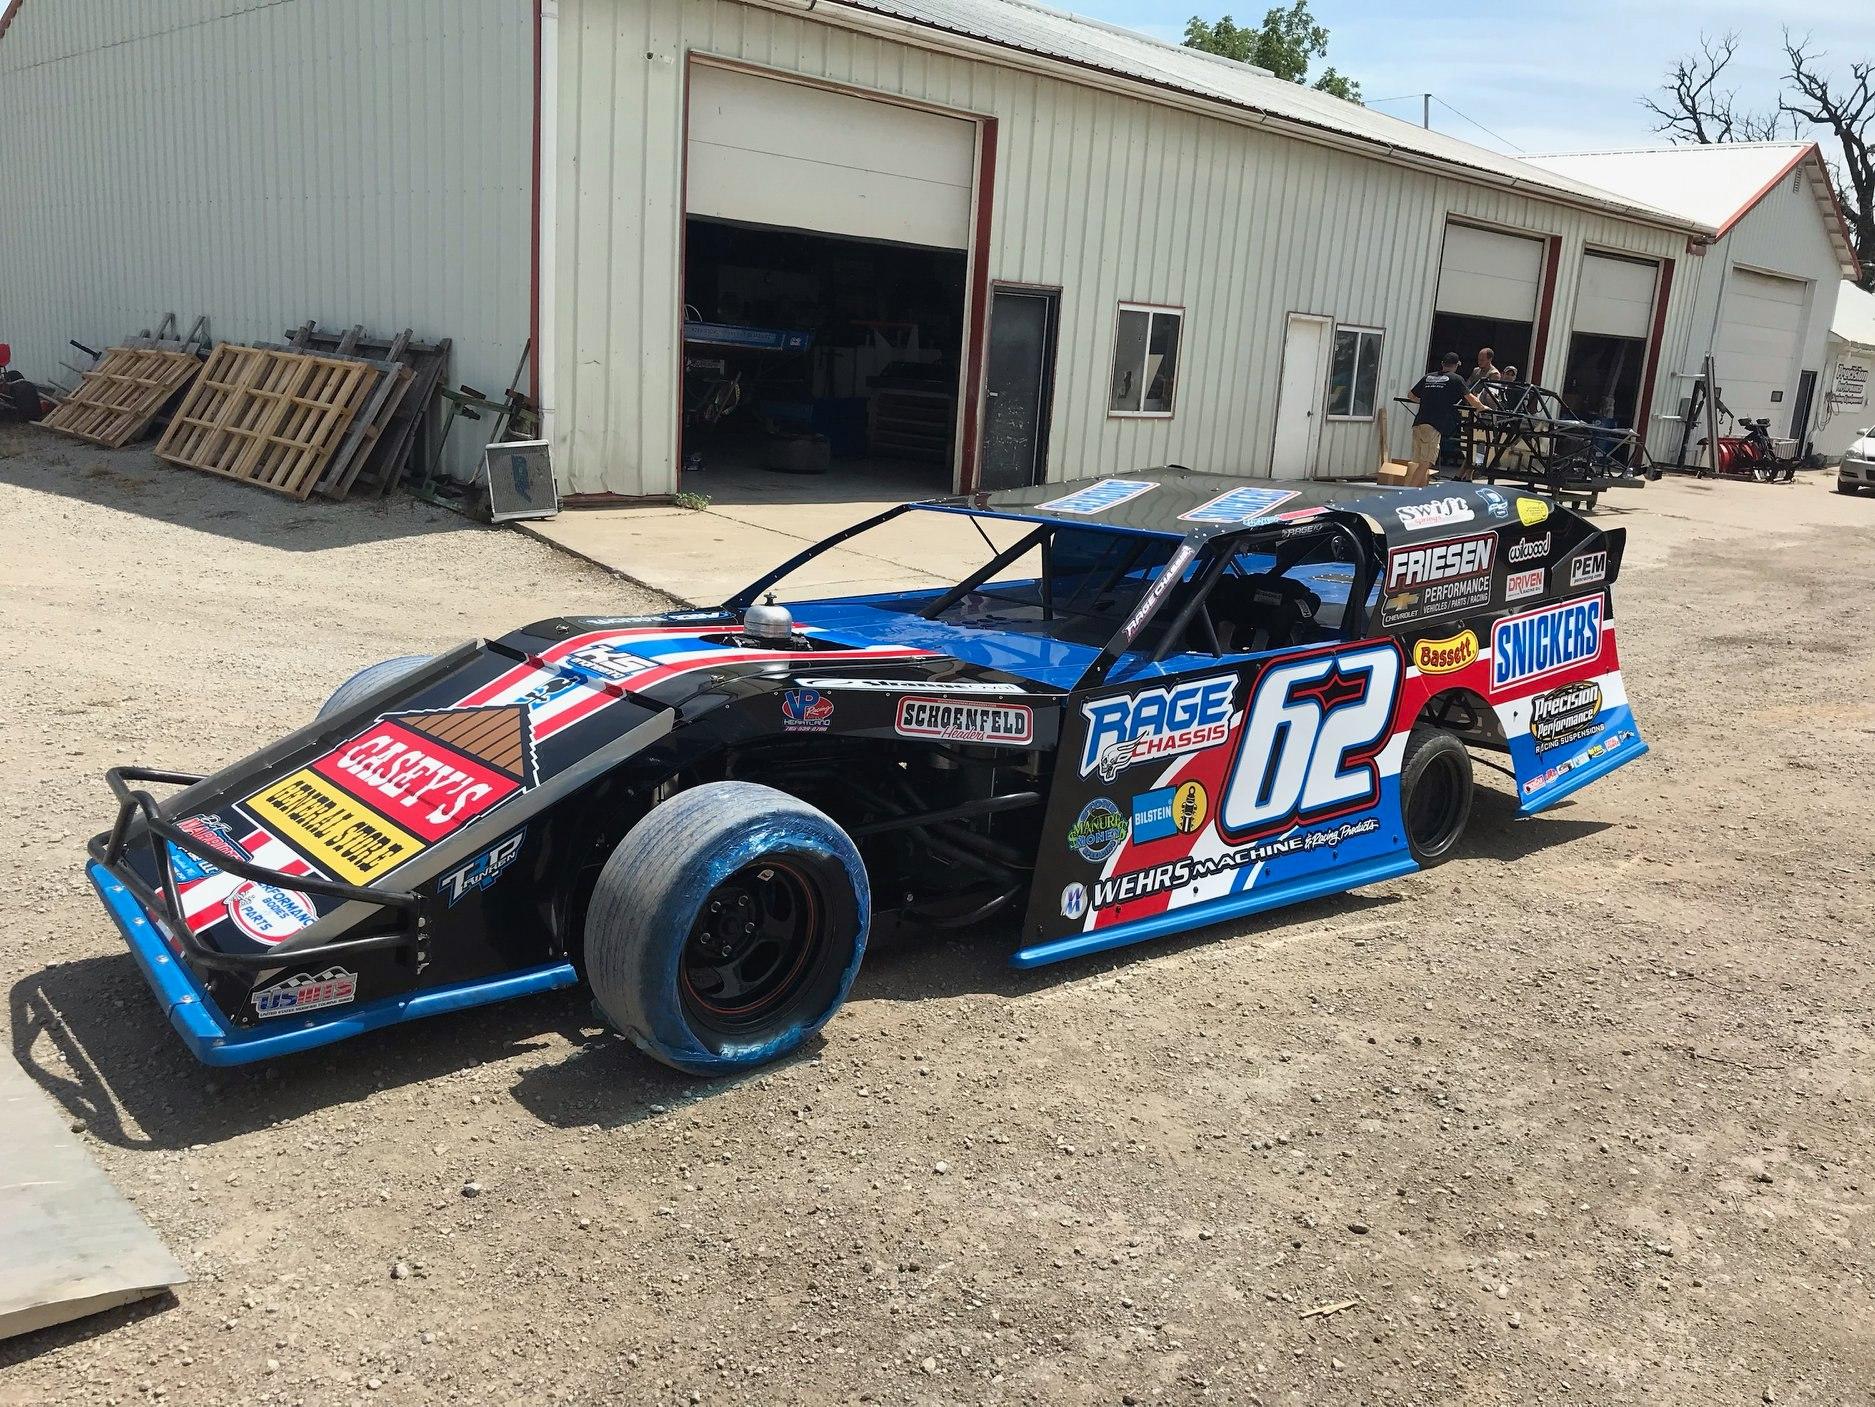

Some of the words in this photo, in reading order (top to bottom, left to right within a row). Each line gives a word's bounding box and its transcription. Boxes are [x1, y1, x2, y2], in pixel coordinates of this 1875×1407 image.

[1389, 538, 1493, 588] FRIESEN
[1573, 554, 1605, 578] PEM
[1424, 576, 1490, 603] PERFORMANCE
[1508, 572, 1543, 592] DRIVEN
[1126, 594, 1157, 637] RAGE
[1385, 610, 1419, 622] CHEVROLET
[1423, 601, 1448, 614] VEHICLES
[1451, 598, 1467, 609] PARTS
[1470, 593, 1488, 604] RACING
[1420, 637, 1471, 667] Bassett
[1497, 601, 1598, 683] SNICKERS
[785, 689, 820, 719] VP
[1534, 686, 1598, 721] Precision
[784, 718, 831, 726] HEARTLAND
[904, 703, 1025, 735] SCHOENFELD
[940, 726, 985, 741] Headers
[1086, 681, 1235, 767] RAGE
[1538, 709, 1594, 739] Performance
[1131, 724, 1226, 759] CHASSIS
[1222, 645, 1400, 832] 62
[1536, 740, 1559, 754] RACING
[1561, 724, 1605, 745] SUSPENSIONS
[337, 735, 493, 824] CASEY'S
[265, 779, 354, 838] GENERAL
[322, 820, 404, 873] STORE
[1074, 812, 1121, 835] MANURE
[1135, 806, 1172, 826] BILSTEIN
[1094, 860, 1193, 908] WEHRS
[1192, 837, 1304, 879] MACHINE
[1311, 829, 1340, 849] Racing
[1339, 819, 1380, 839] Products
[242, 906, 274, 932] PARTS
[262, 897, 291, 920] BODIES
[258, 979, 353, 1010] USMTS
